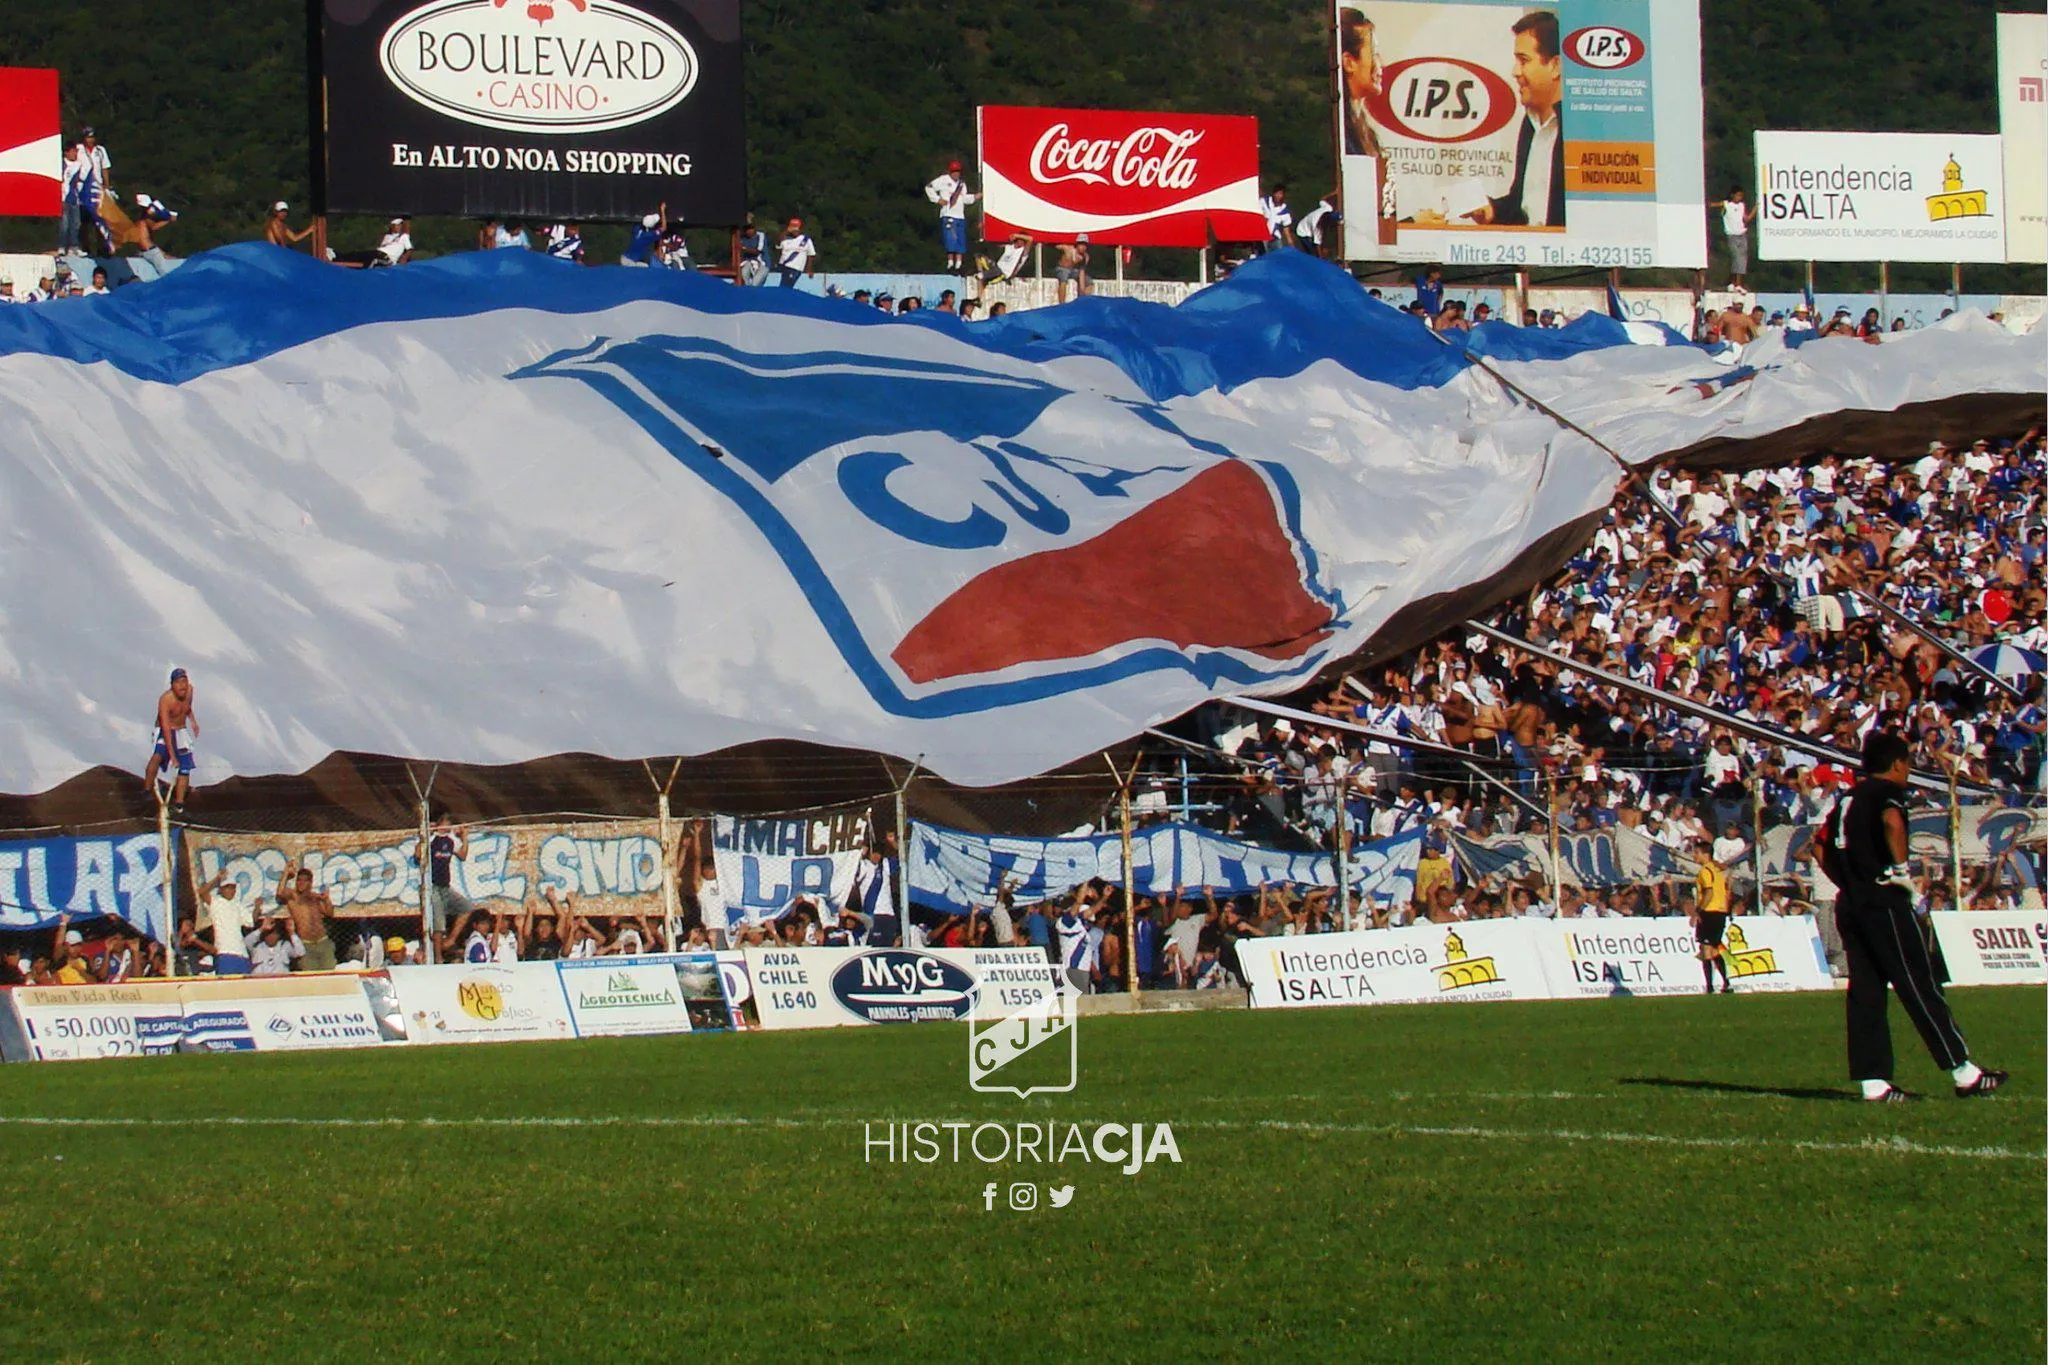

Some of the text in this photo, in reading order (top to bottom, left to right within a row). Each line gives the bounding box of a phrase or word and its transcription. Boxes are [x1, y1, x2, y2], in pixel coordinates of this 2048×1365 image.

[418, 31, 665, 81] BOULEVARD
[1585, 36, 1628, 58] I.P.S.
[488, 81, 599, 111] CASINO
[1404, 78, 1478, 120] I.P.S.
[392, 144, 692, 176] En ALTO NOA SHOPPING
[1030, 123, 1205, 189] Coca-Cola
[1440, 149, 1513, 164] PROVINCIAL
[1401, 163, 1443, 176] SALUD
[1448, 165, 1465, 177] DE
[1468, 165, 1505, 178] SALTA
[1581, 171, 1643, 185] INDIVIDUAL
[1768, 163, 1913, 192] Intendencia
[1450, 244, 1490, 262] Mitre
[1496, 245, 1527, 263] 243
[1542, 246, 1575, 264] Tel.:
[1580, 246, 1652, 265] 4323155
[1572, 931, 1697, 956] Intendenci
[1972, 927, 2033, 950] SALTA
[764, 954, 800, 966] AVDA
[1280, 943, 1428, 974] Intendencia
[759, 970, 809, 985] CHILE
[860, 956, 945, 995] MyG
[34, 989, 143, 1003] Plan Vida Real
[771, 990, 817, 1010] 1.640
[1000, 988, 1043, 1006] 1.559
